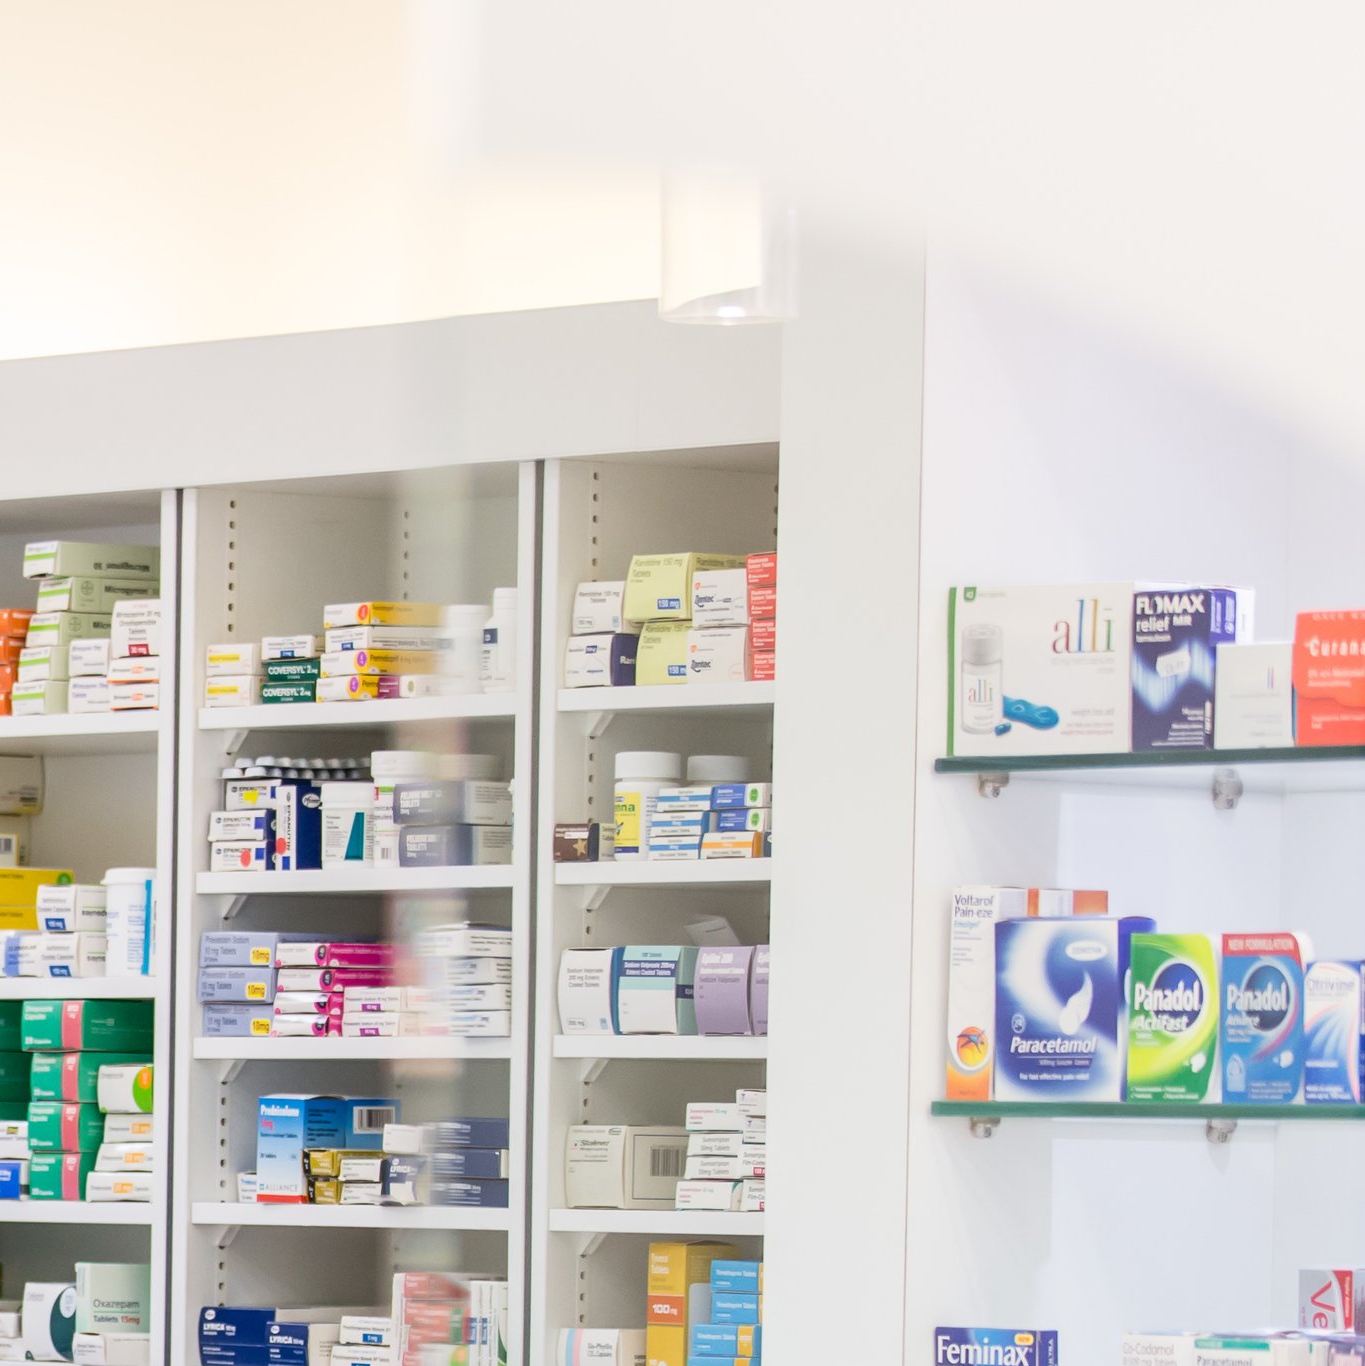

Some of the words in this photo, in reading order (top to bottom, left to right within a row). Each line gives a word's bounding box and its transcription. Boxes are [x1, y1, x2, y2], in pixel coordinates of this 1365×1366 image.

[1135, 615, 1170, 633] relief
[1172, 614, 1193, 627] MR
[268, 666, 305, 675] COVERSYL
[262, 688, 298, 697] COVERSYL
[954, 894, 994, 906] Voltarol
[954, 906, 993, 918] Pain-eze
[1134, 980, 1202, 1011] Panadol
[1226, 981, 1288, 1011] Panadol
[1135, 1014, 1189, 1031] ActiFast
[1010, 1036, 1097, 1054] Paracetamol
[264, 1183, 298, 1191] ALLIANCE
[93, 1299, 140, 1310] Oxazepam
[93, 1315, 118, 1323] Tablets
[121, 1315, 141, 1325] 15mg
[203, 1323, 225, 1331] LYRICA
[269, 1335, 294, 1344] LYRICA
[937, 1335, 1029, 1366] Feminax
